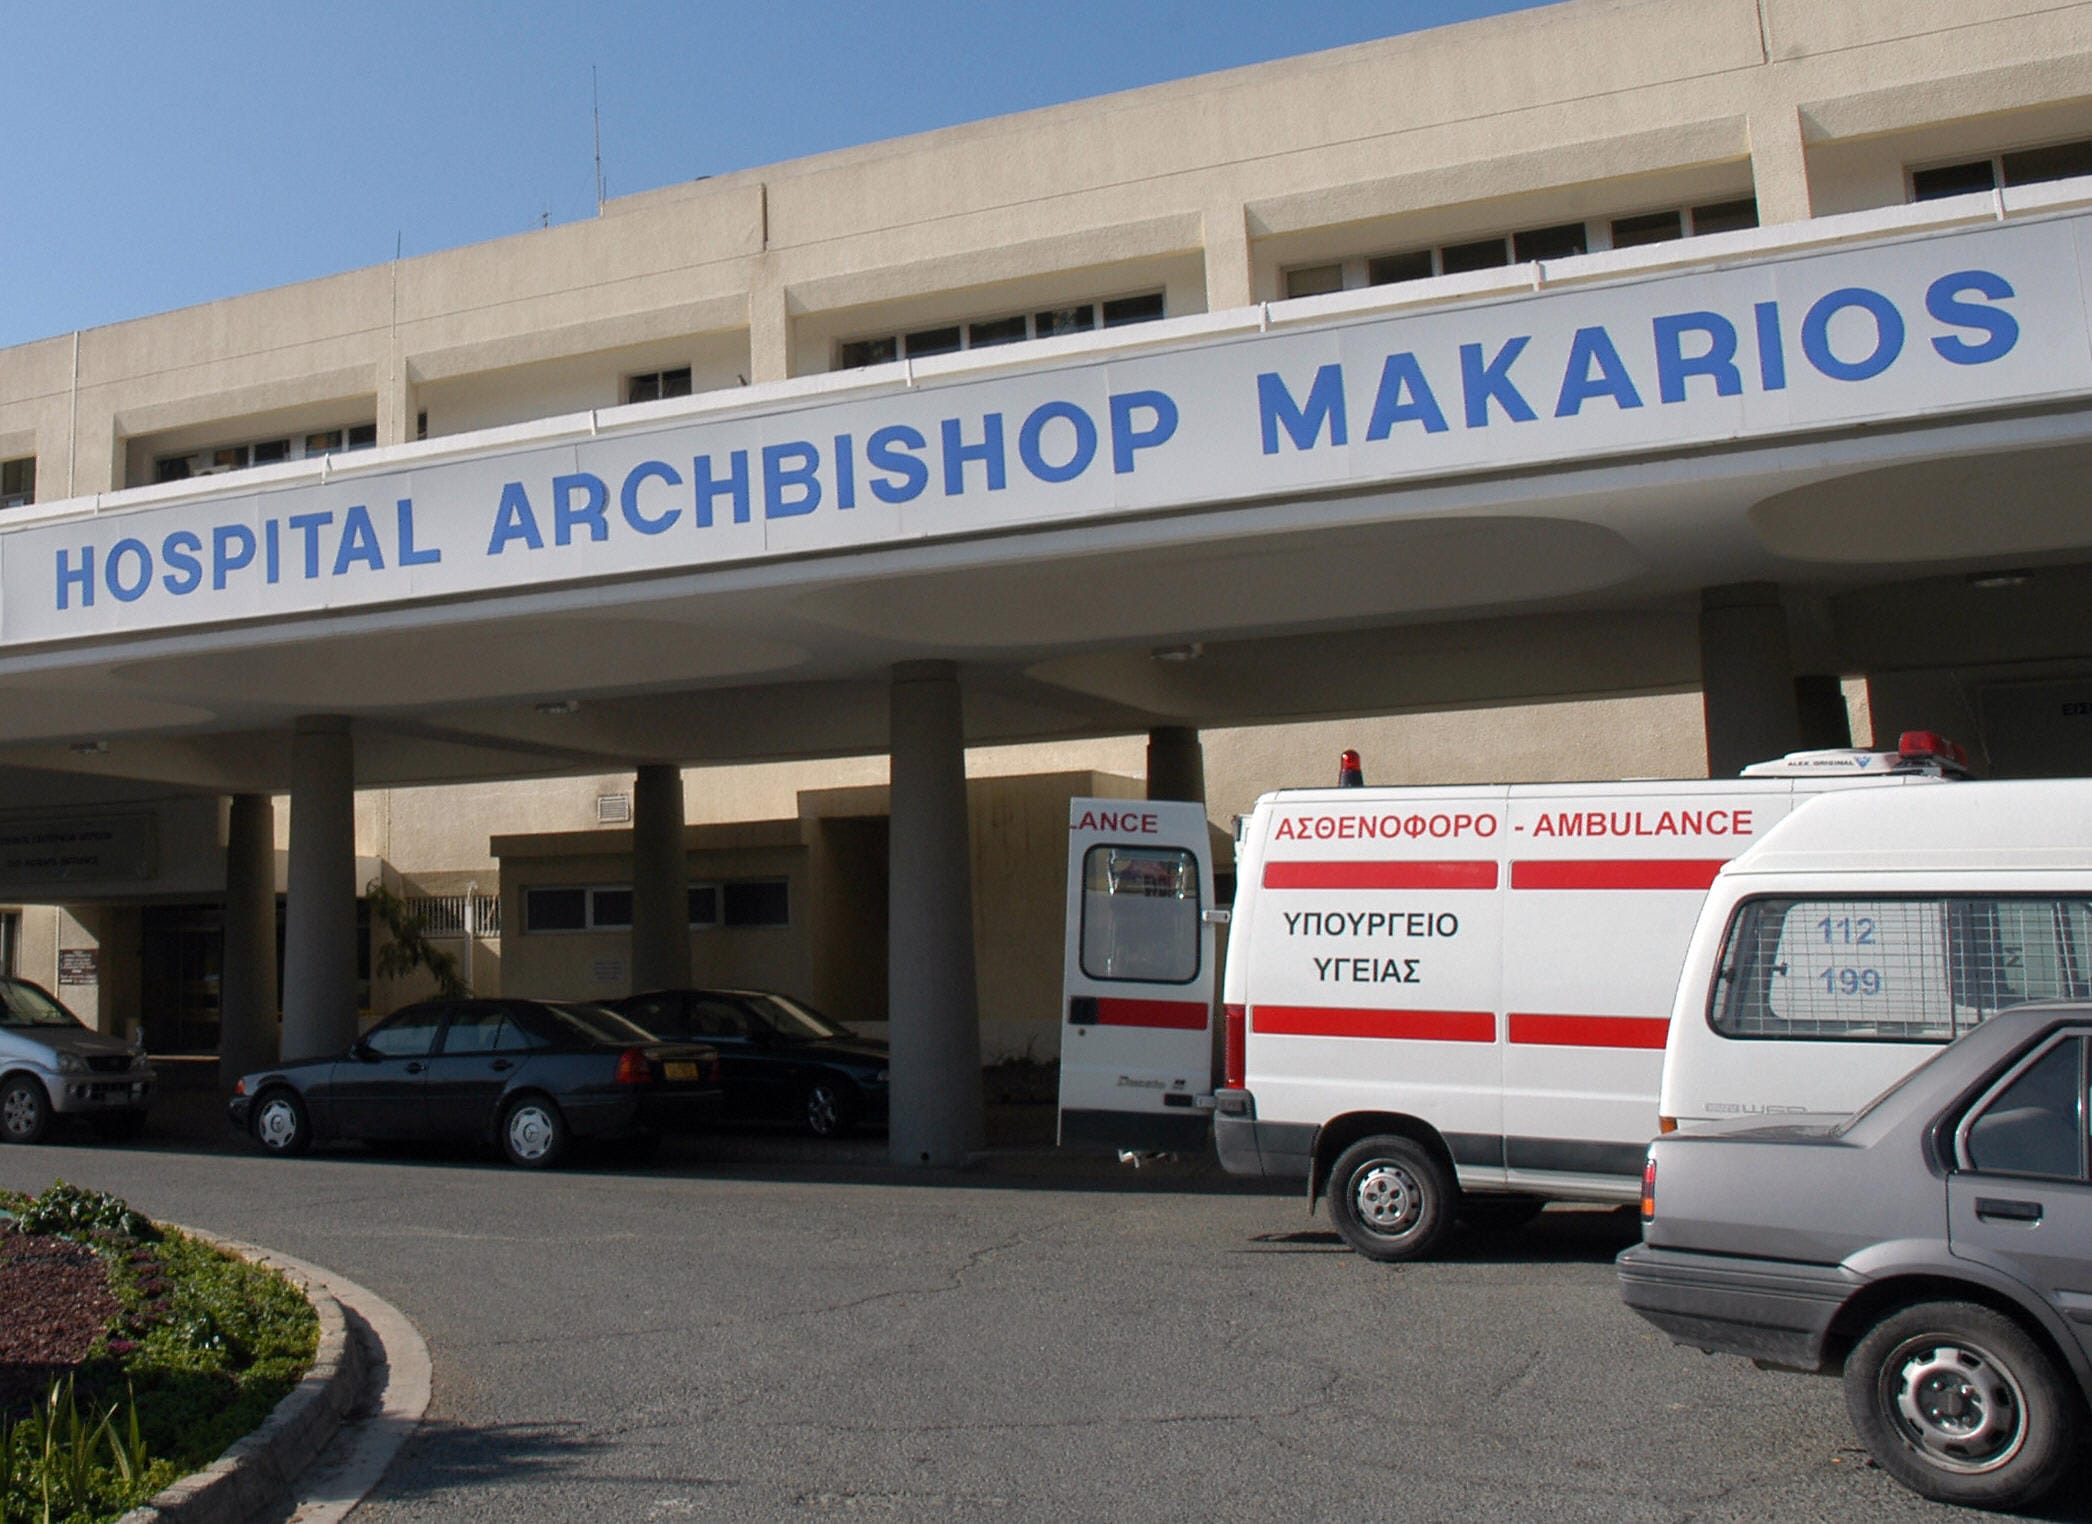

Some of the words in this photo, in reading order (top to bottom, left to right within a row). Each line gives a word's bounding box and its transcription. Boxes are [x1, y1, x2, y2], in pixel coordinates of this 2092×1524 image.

[57, 499, 441, 610] HOSPITAL
[488, 390, 1179, 555] ARCHBISHOP
[1257, 270, 2021, 455] MAKARIOS
[2062, 703, 2092, 716] ΕΙΣ
[1275, 813, 1498, 840] ΑΣΘΕΝΟΦΟΡΟ
[1533, 810, 1753, 837] AMBULANCE
[1284, 912, 1459, 938] ΥΠΟΥΡΓΕΙΟ
[1818, 916, 1876, 945] 112
[1313, 957, 1421, 983] ΥΓΕΙΑΣ
[1820, 967, 1881, 995] 199
